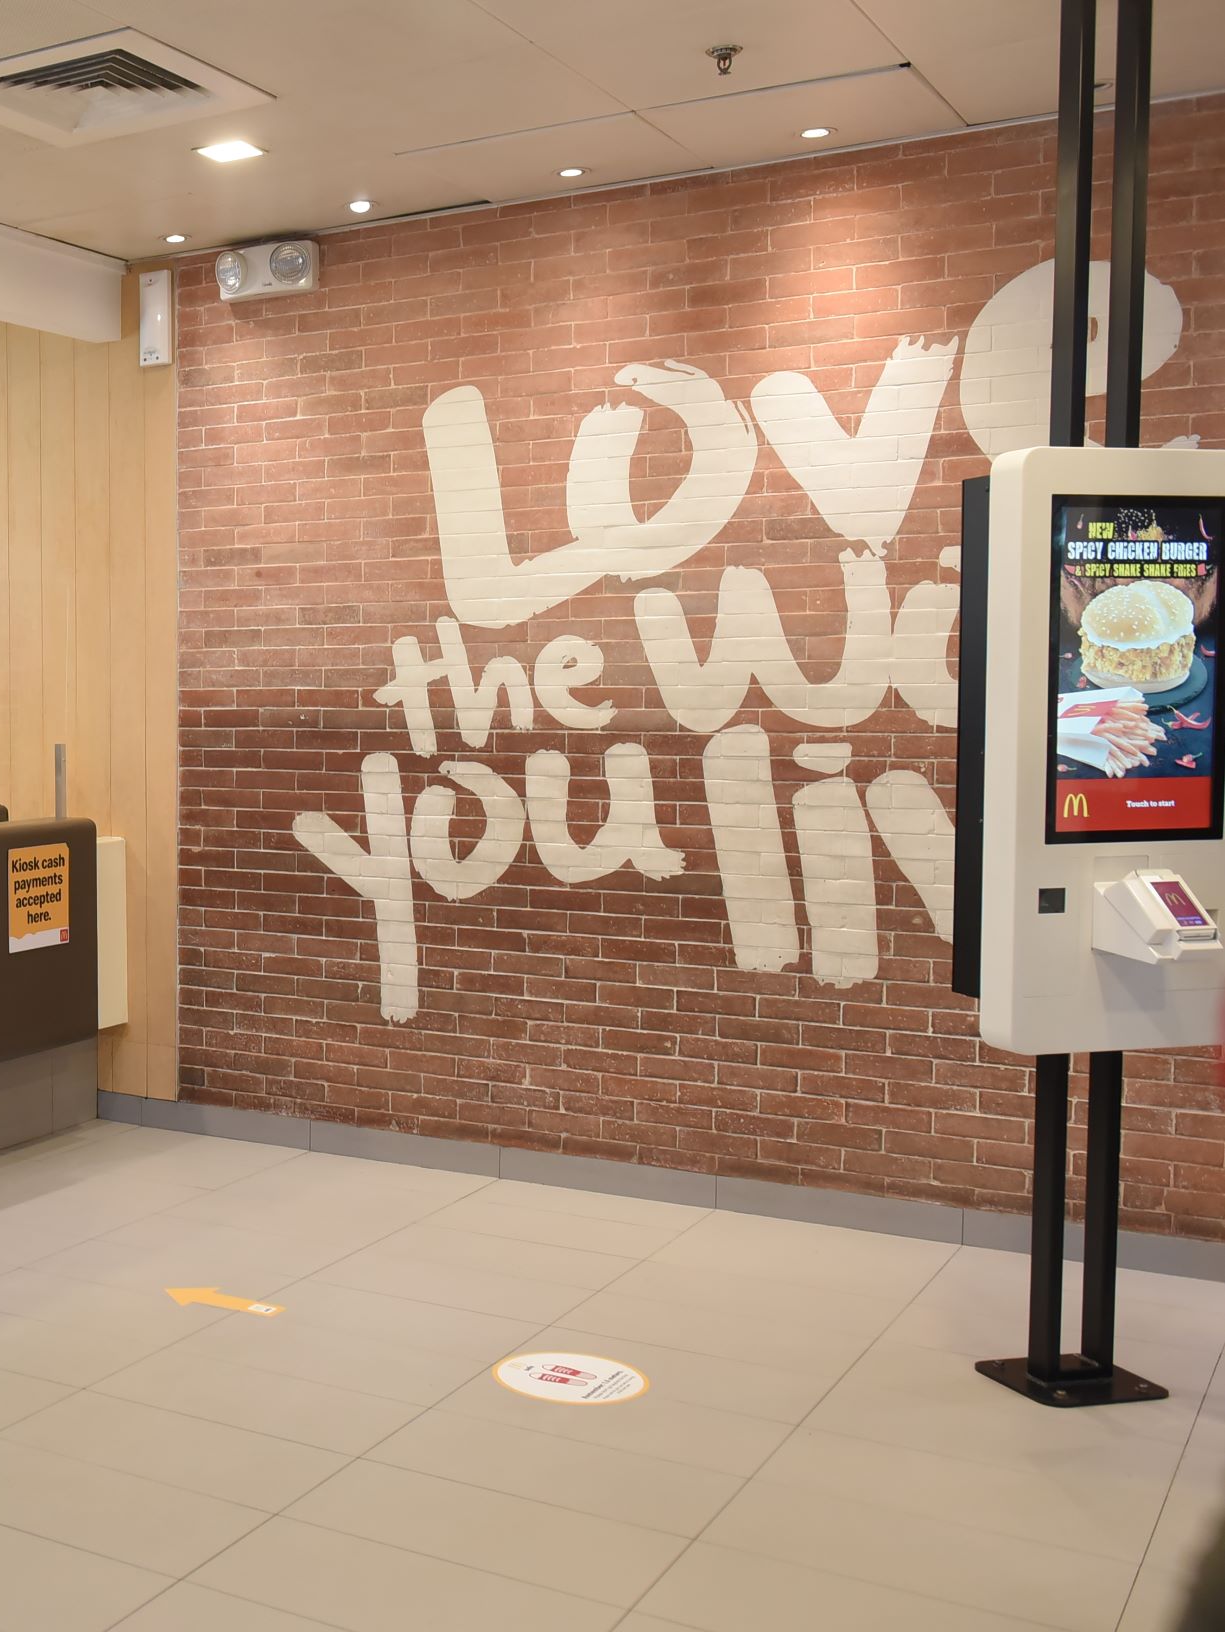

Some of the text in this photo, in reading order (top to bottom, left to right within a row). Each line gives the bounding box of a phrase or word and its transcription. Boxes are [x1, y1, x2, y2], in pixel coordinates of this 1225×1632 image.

[1088, 521, 1115, 540] NEW
[1161, 541, 1208, 561] BURGER
[1113, 564, 1141, 577] SHAKE
[1143, 564, 1171, 577] SHAKE
[373, 614, 616, 758] the
[1126, 800, 1176, 809] Touch to start
[11, 853, 66, 874] Kiosk cash
[14, 872, 64, 895] payments
[292, 742, 686, 1025] you
[15, 888, 62, 909] accepted
[27, 910, 52, 925] here.
